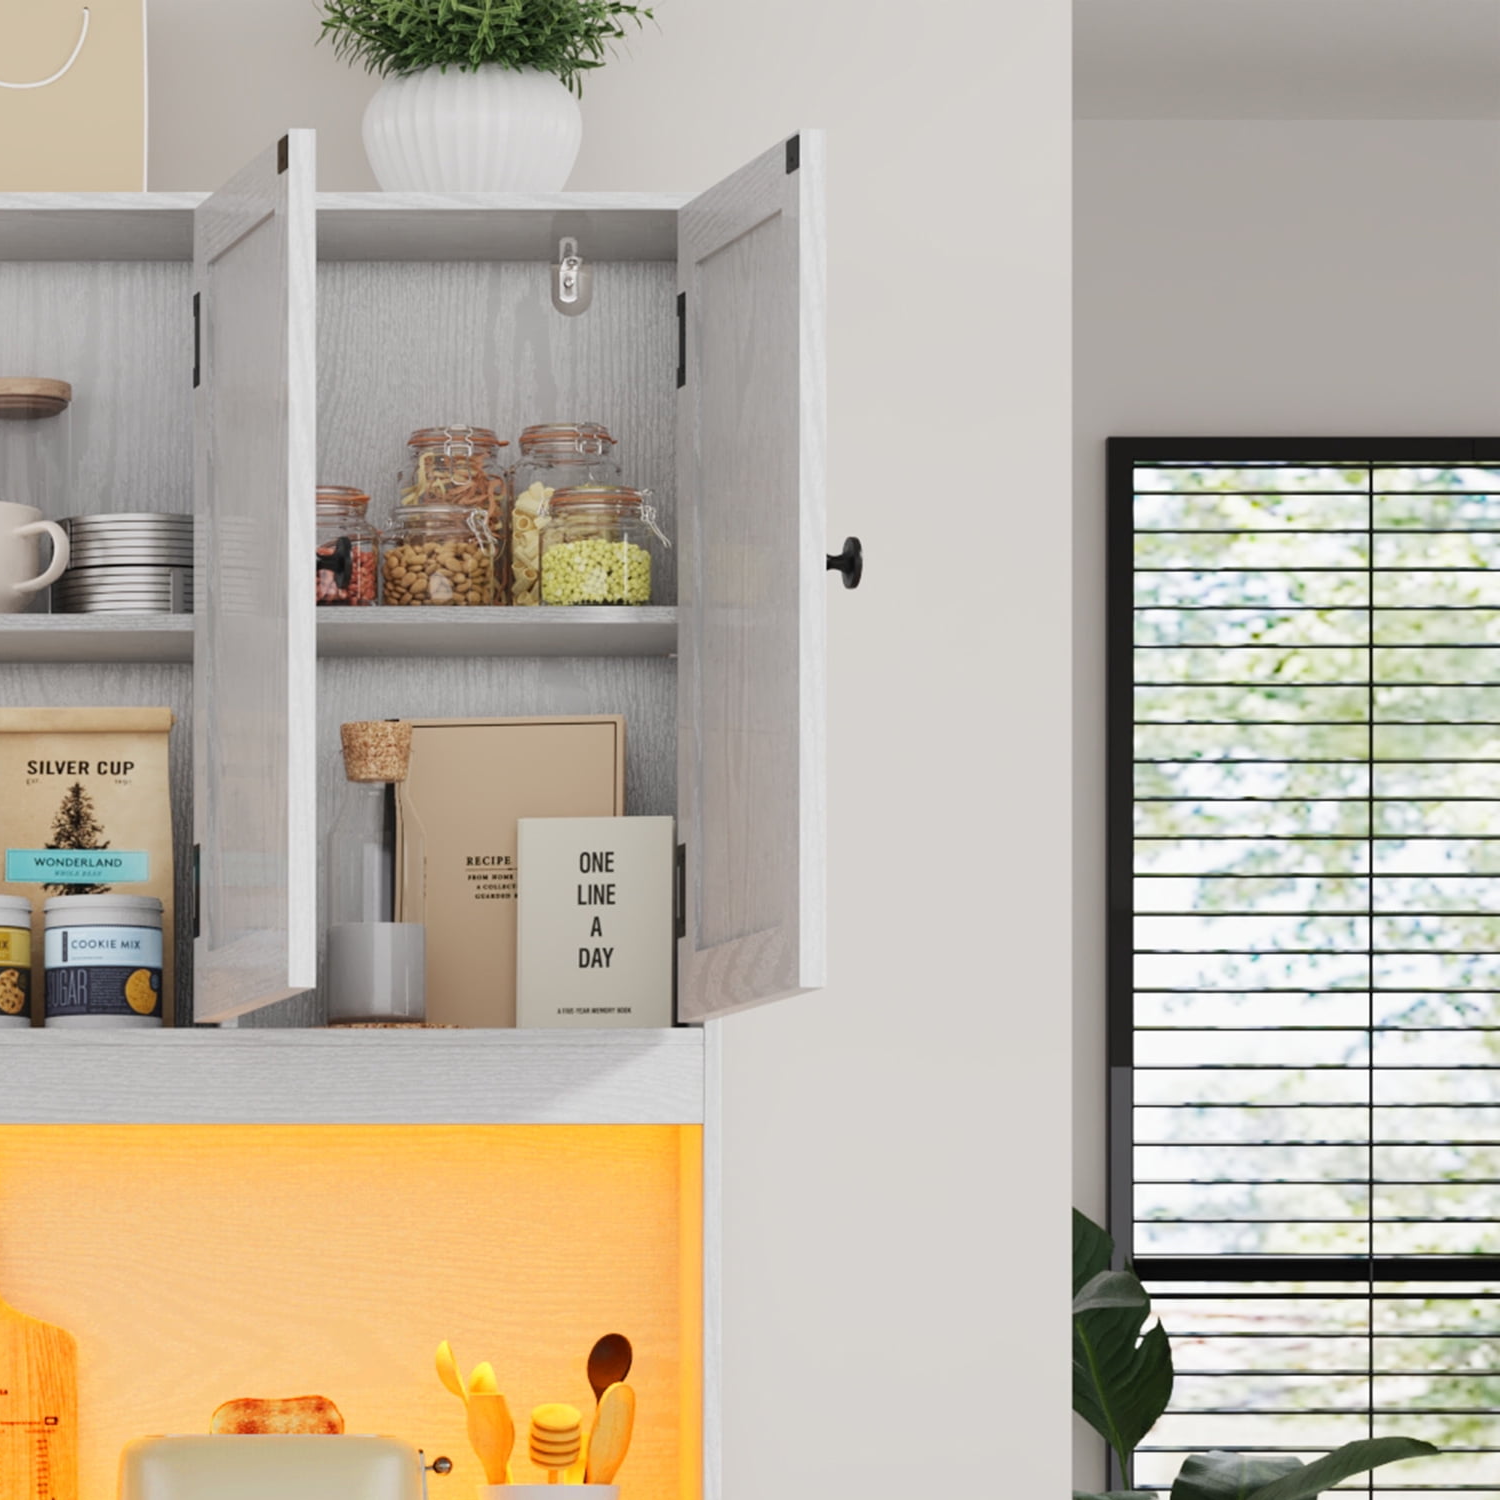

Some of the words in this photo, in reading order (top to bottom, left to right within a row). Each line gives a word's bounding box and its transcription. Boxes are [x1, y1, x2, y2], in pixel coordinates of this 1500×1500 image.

[27, 760, 90, 775] SILVER
[96, 760, 135, 775] CUP
[34, 857, 123, 868] WONDERLAND
[466, 856, 511, 866] RECIPE
[579, 852, 615, 873] ONE
[577, 884, 616, 905] LINE
[590, 916, 602, 937] A
[71, 939, 117, 950] COOKIE
[120, 939, 141, 950] MIX
[578, 948, 614, 968] DAY
